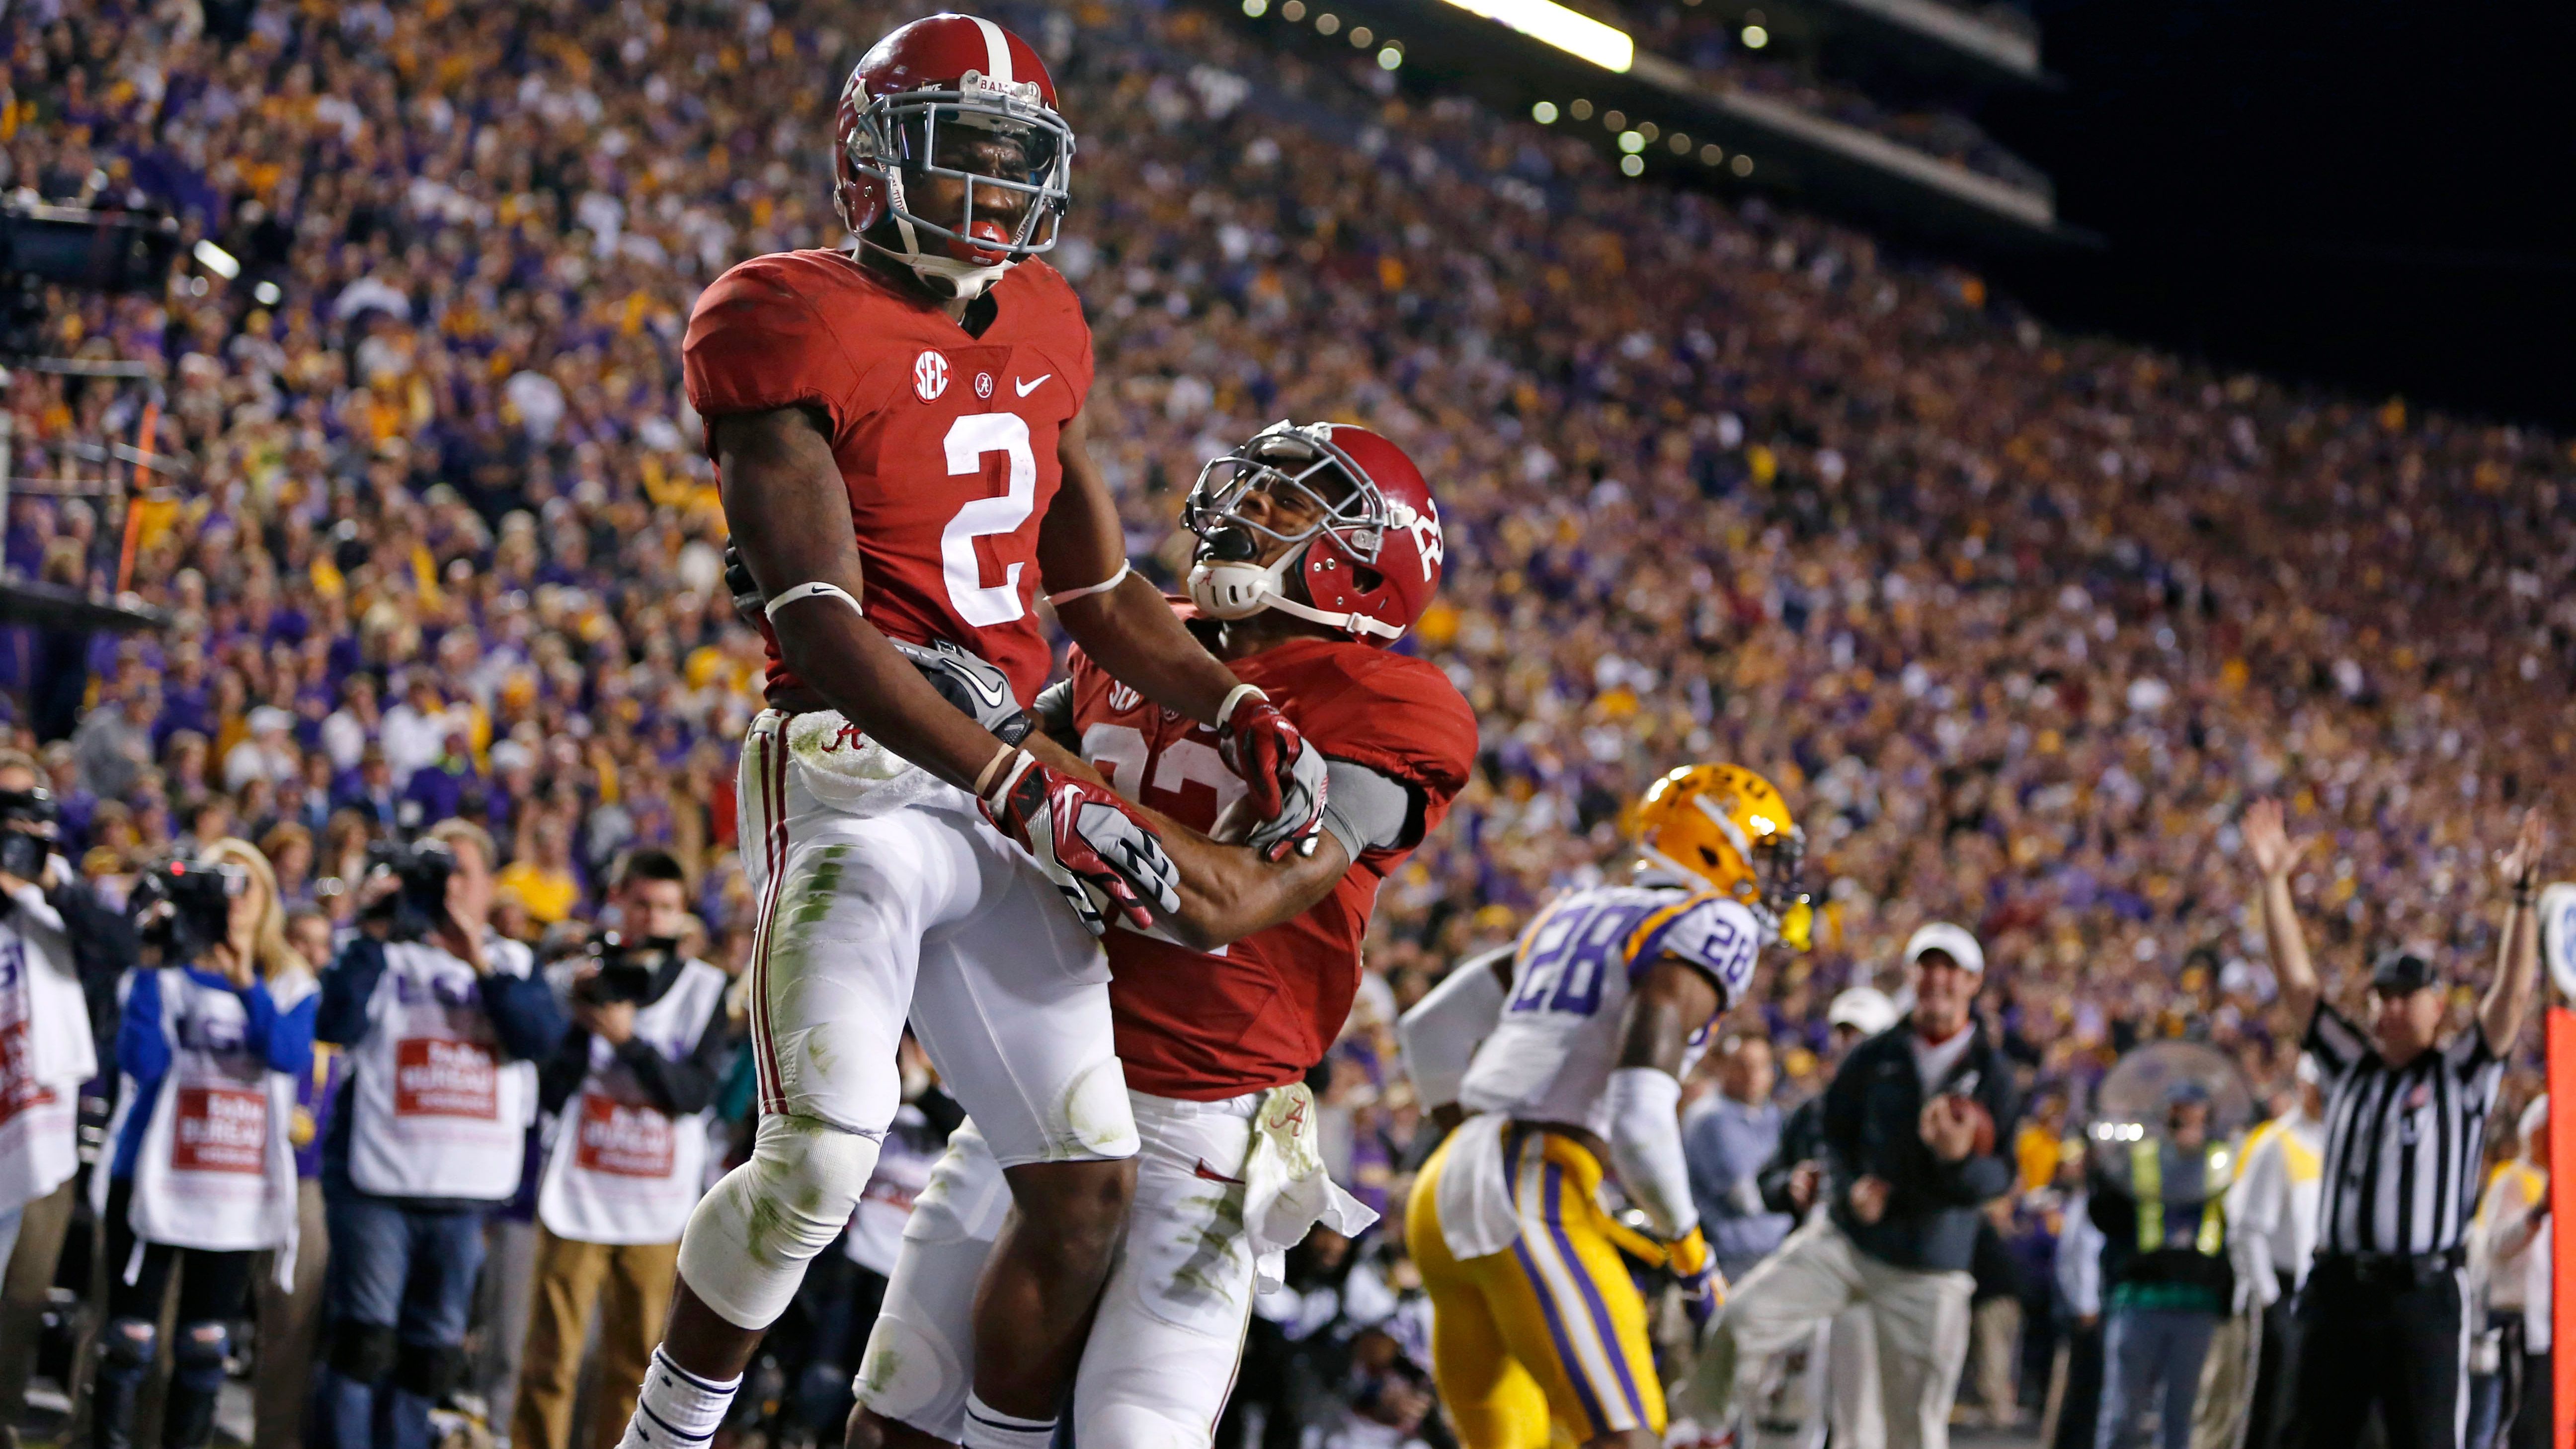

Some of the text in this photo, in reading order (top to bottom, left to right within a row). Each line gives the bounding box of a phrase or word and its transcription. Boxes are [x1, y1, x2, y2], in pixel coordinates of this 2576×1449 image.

[917, 83, 942, 92] NIKE
[915, 351, 949, 400] SEC
[978, 376, 989, 393] A
[941, 412, 1036, 628] 2
[1410, 497, 1444, 582] 22
[1512, 905, 1645, 1017] 28
[1701, 918, 1751, 983] 28
[1270, 1096, 1306, 1137] A
